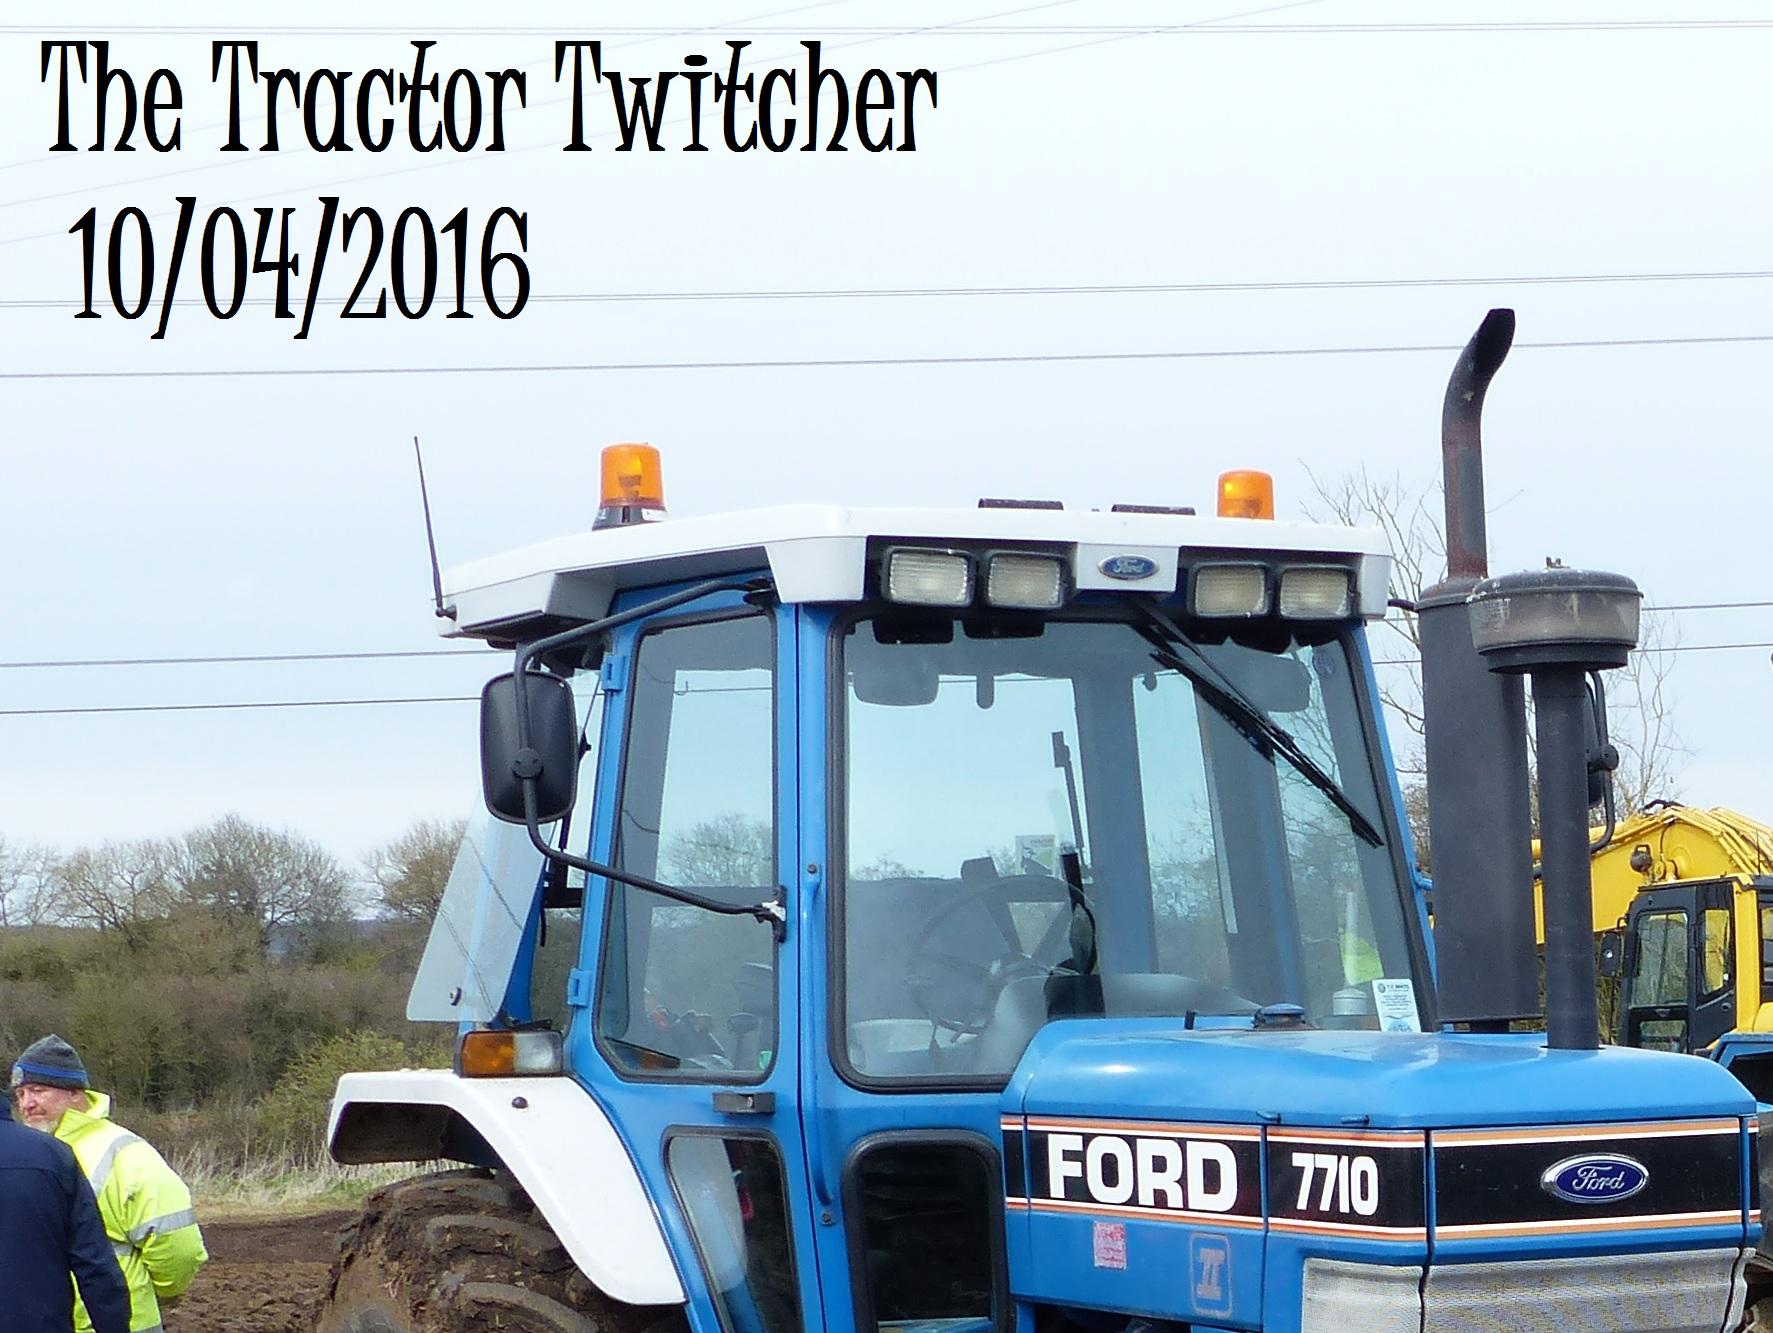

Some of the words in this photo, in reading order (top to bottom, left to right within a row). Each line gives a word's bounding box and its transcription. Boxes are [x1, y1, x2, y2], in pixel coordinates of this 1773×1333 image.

[1114, 559, 1144, 574] Ford
[1048, 1134, 1238, 1212] FORD
[1292, 1152, 1378, 1216] 7710
[1572, 1166, 1625, 1191] Ford
